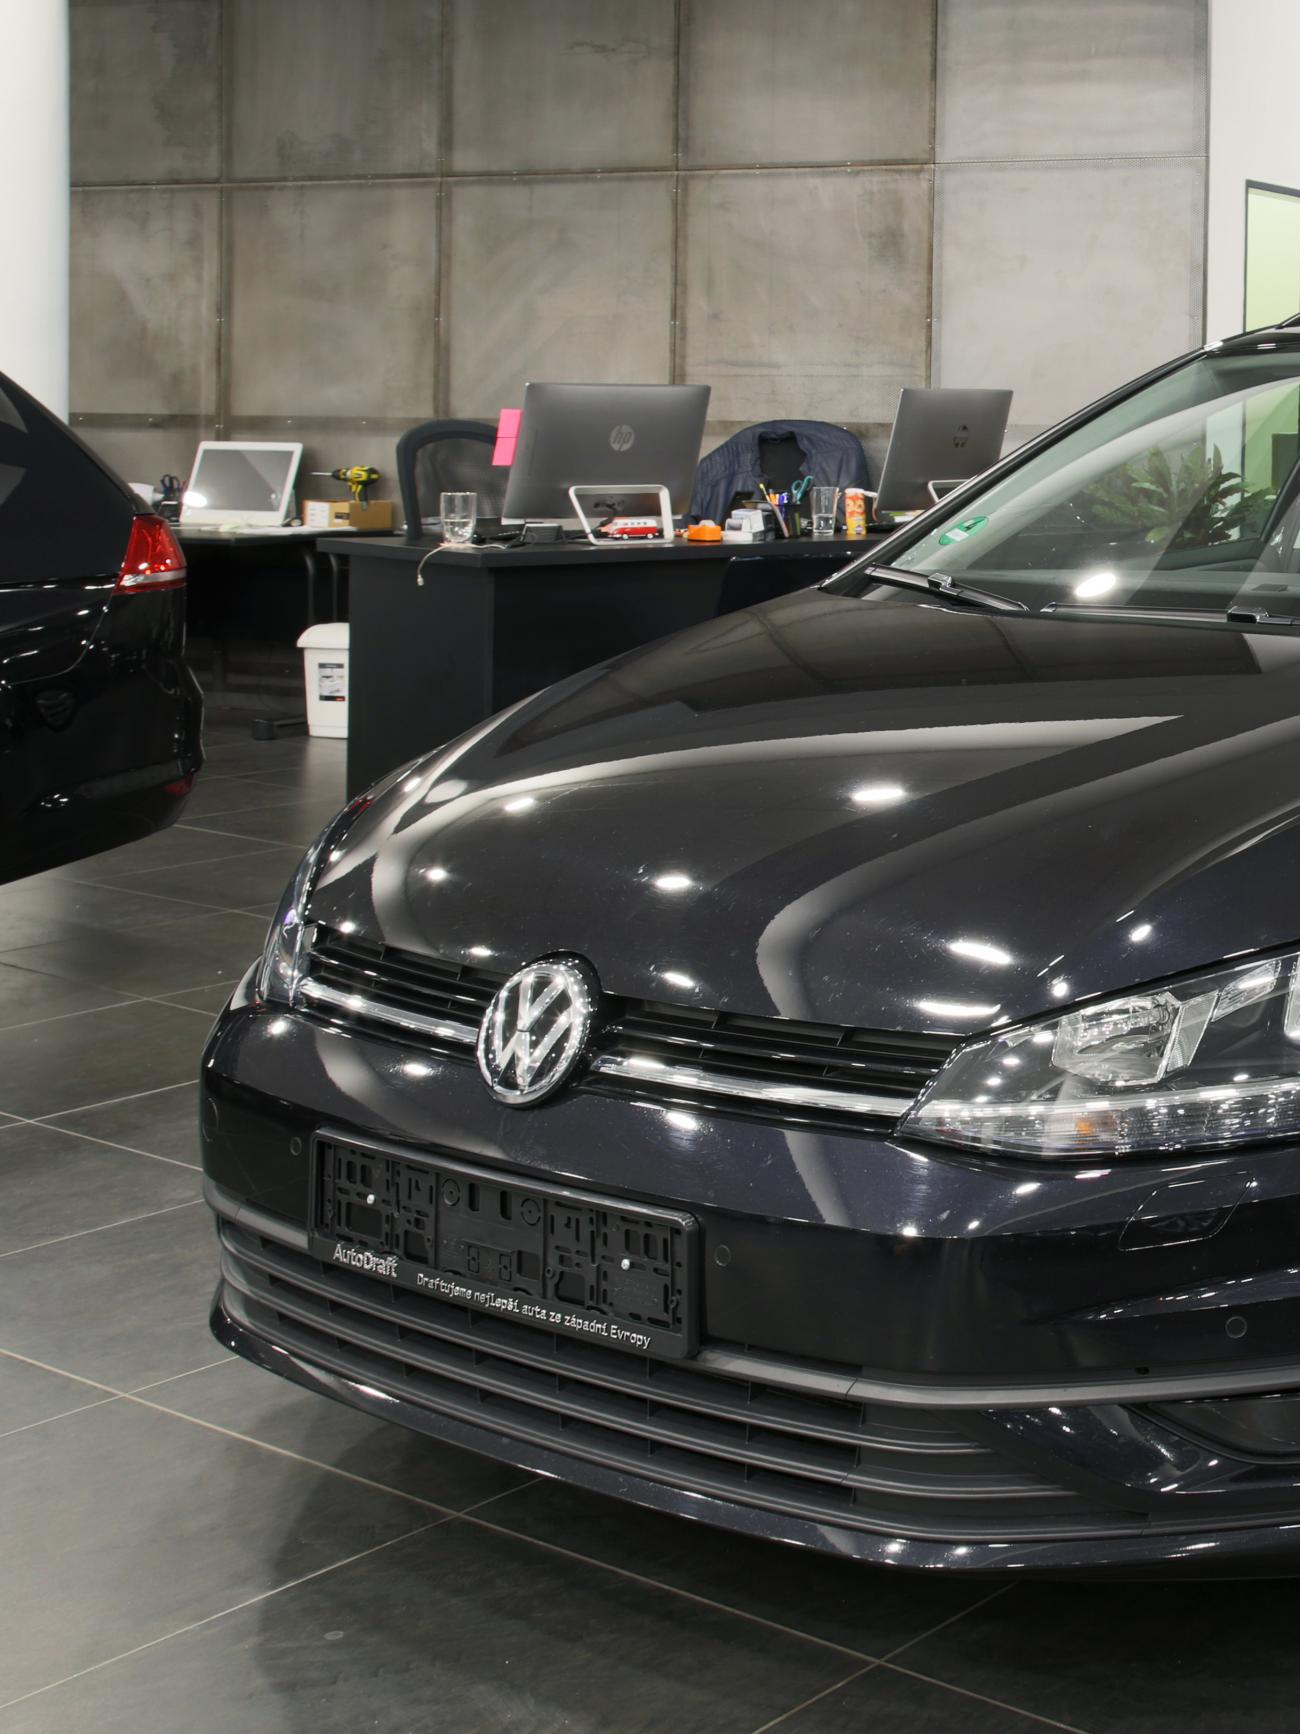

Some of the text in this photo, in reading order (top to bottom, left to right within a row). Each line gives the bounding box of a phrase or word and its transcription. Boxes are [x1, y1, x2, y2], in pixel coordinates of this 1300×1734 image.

[611, 424, 634, 452] hp
[333, 1243, 398, 1278] AutoDraft
[416, 1273, 652, 1351] Draftujeme nejlepší auta ze západní Evropy
